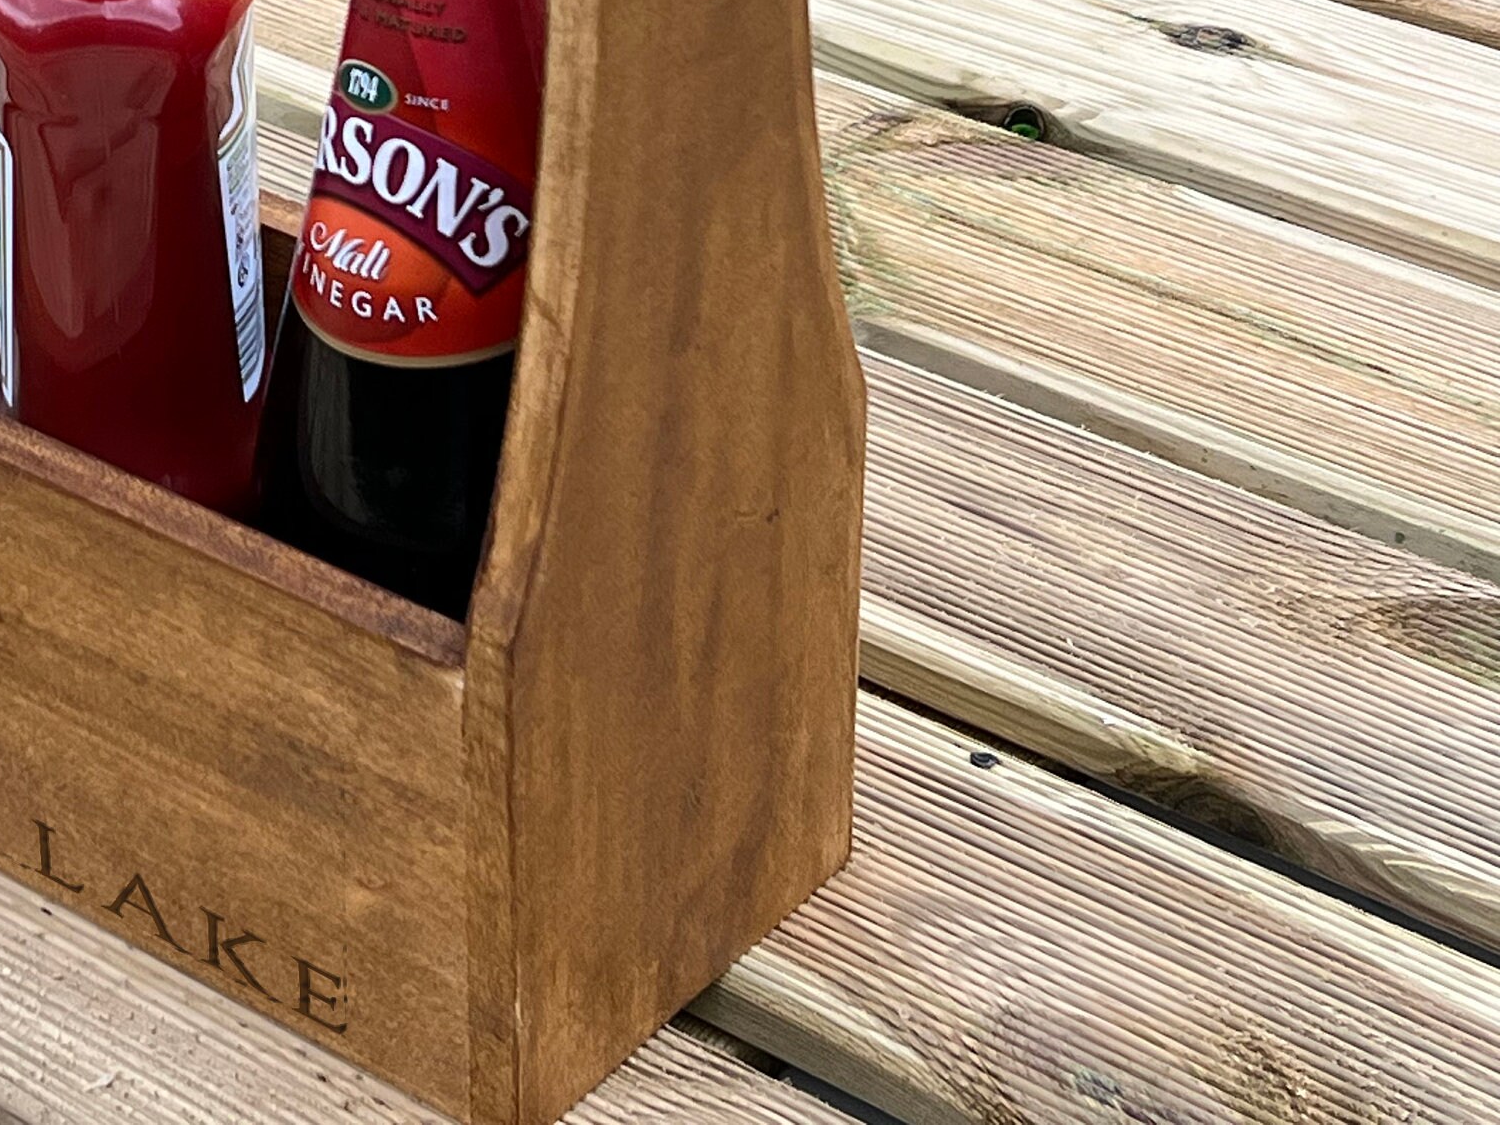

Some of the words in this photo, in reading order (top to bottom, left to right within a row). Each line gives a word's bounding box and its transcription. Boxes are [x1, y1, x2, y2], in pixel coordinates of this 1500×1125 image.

[348, 68, 379, 103] 1794
[404, 93, 449, 111] SINCE
[32, 819, 348, 1034] LAKE
